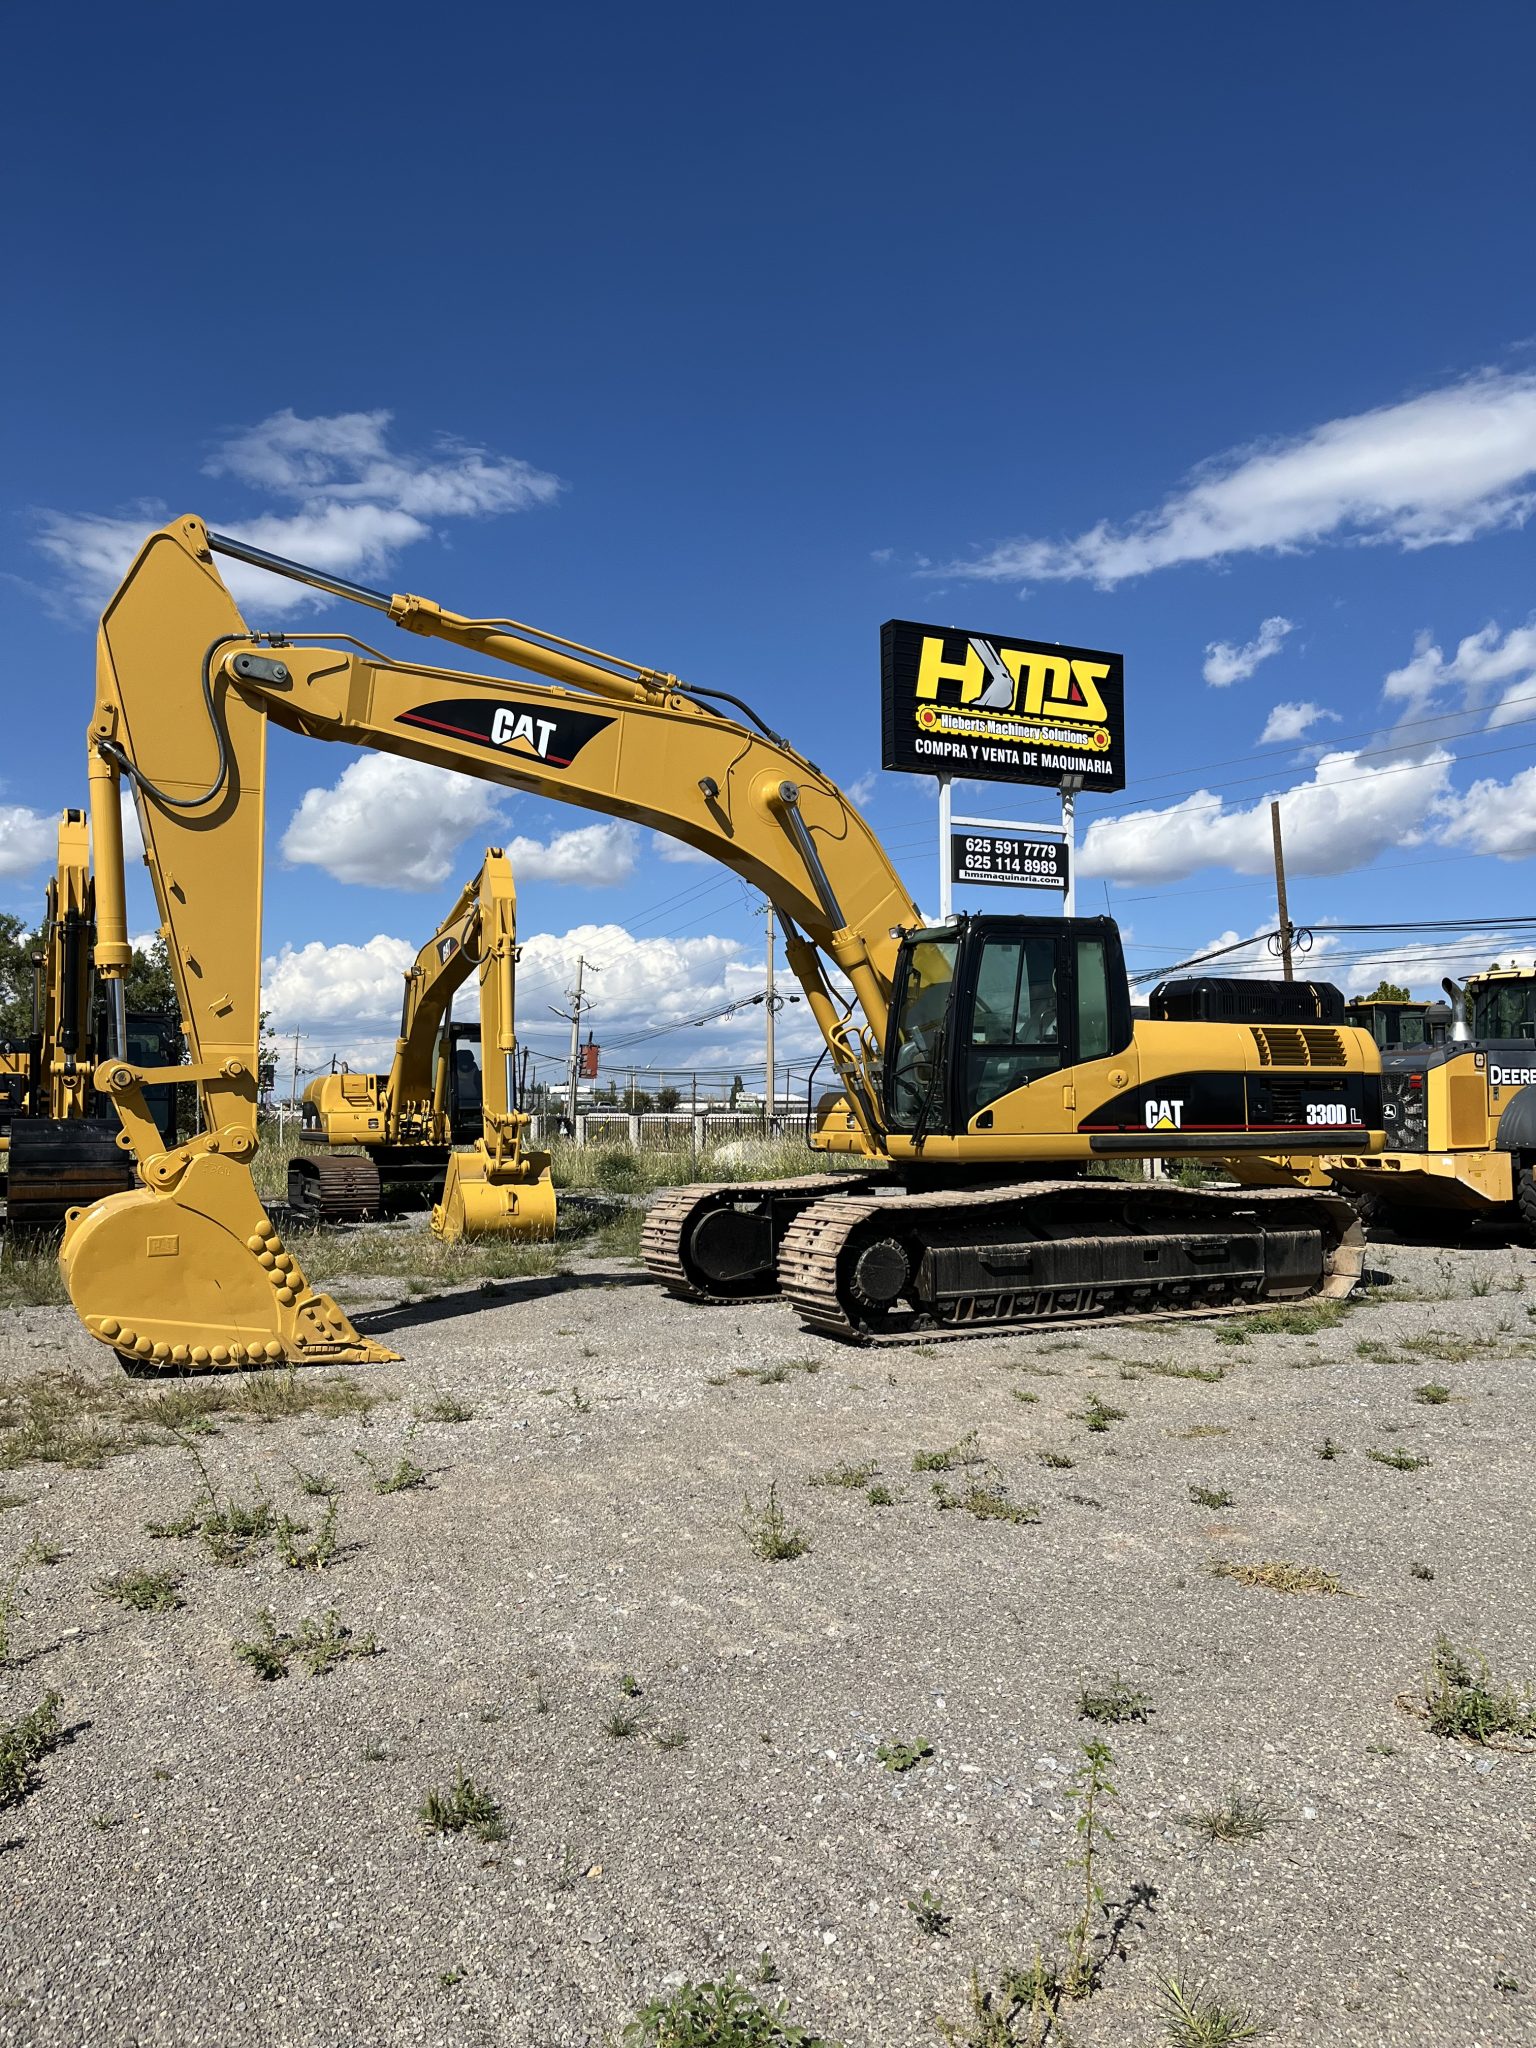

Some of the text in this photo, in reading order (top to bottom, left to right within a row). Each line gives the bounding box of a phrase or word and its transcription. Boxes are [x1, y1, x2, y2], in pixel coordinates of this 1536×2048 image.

[491, 708, 557, 759] CAT
[941, 714, 1089, 744] Hieberts Machinery Solutions
[915, 739, 1113, 775] COMPRA Y VENTA DE MAQUINARIA
[965, 838, 1057, 858] 625 591 7779
[965, 854, 1057, 875] 625 114 8989
[964, 871, 1060, 884] hmsmaquinaria.com
[1490, 1065, 1536, 1085] DEERE
[1145, 1100, 1184, 1129] CAT
[1306, 1104, 1362, 1125] 330D L
